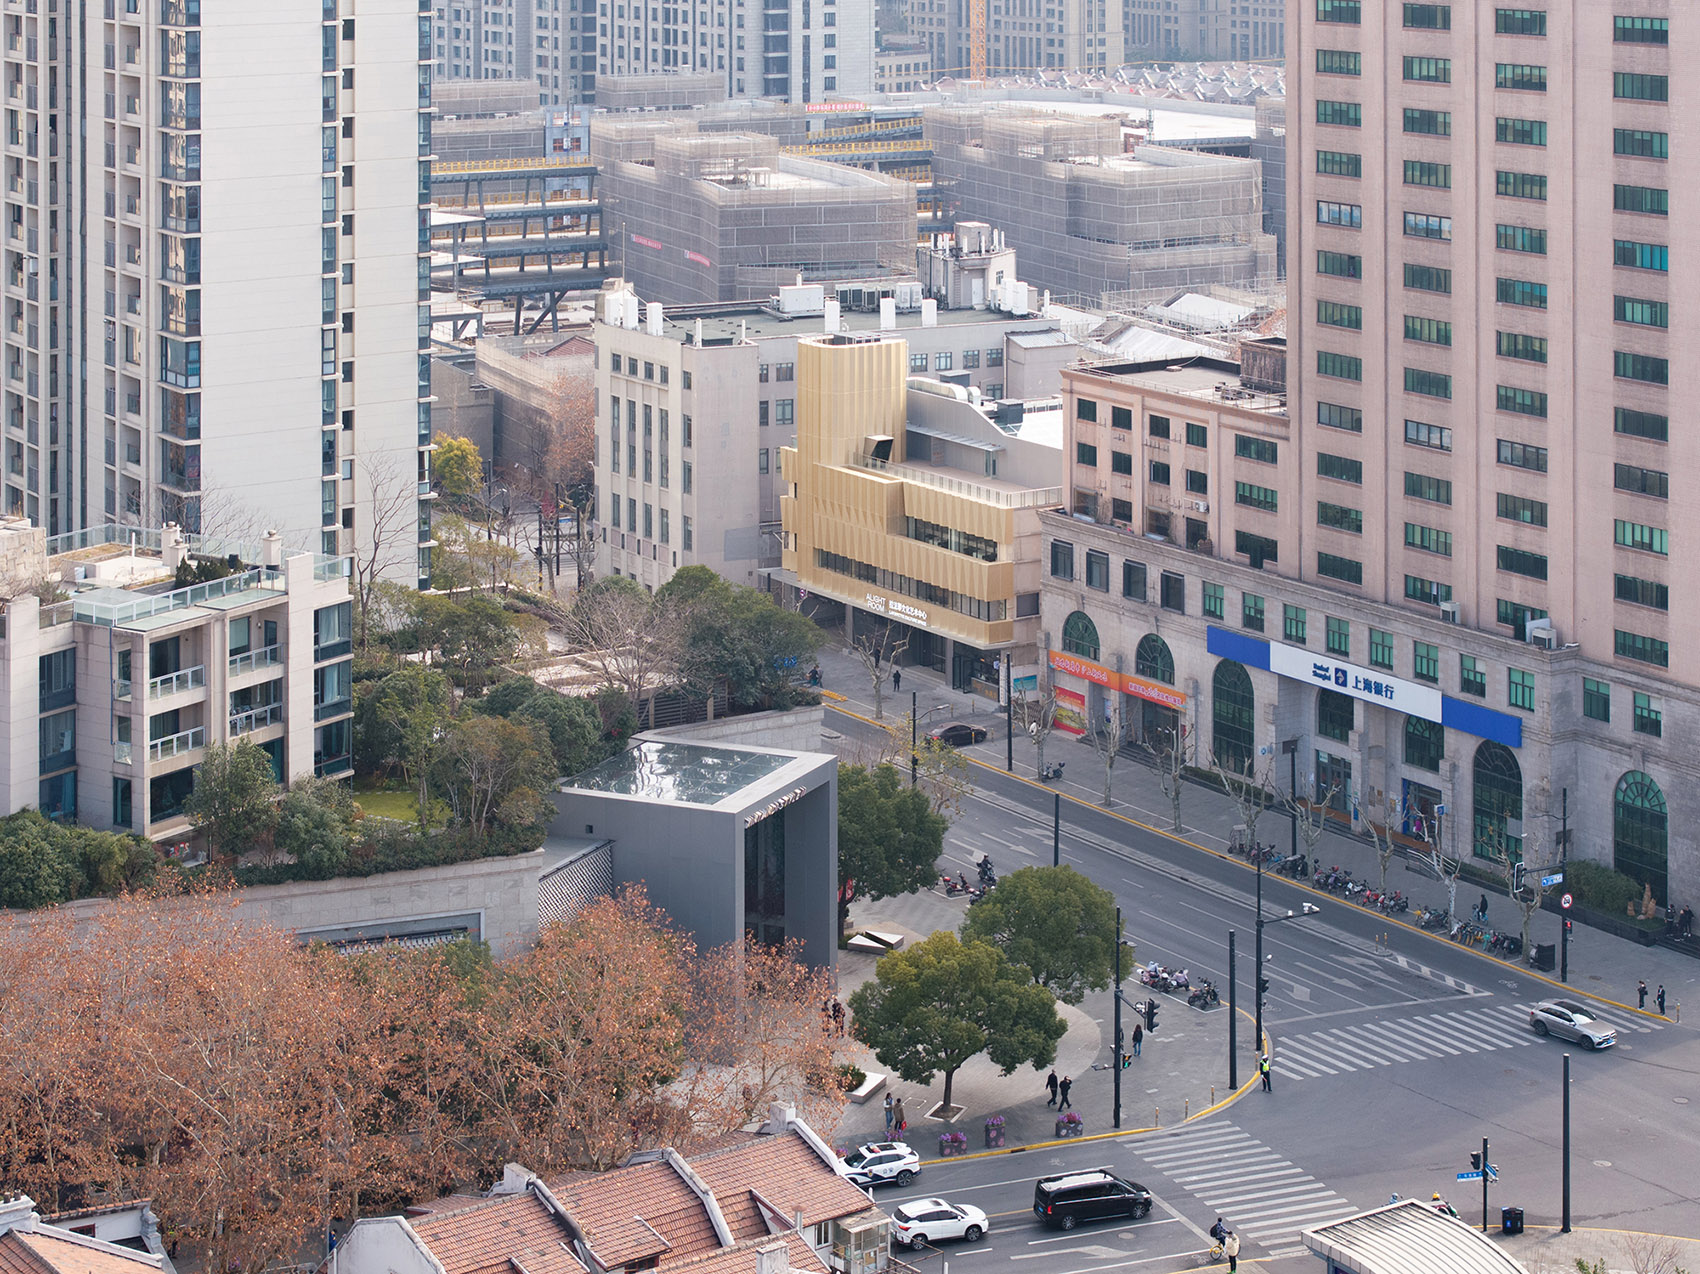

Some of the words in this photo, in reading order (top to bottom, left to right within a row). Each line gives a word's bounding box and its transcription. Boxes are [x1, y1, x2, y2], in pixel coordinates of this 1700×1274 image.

[866, 593, 885, 604] ALIGHT
[868, 601, 884, 611] ROOM
[1352, 675, 1395, 700] 上海银行
